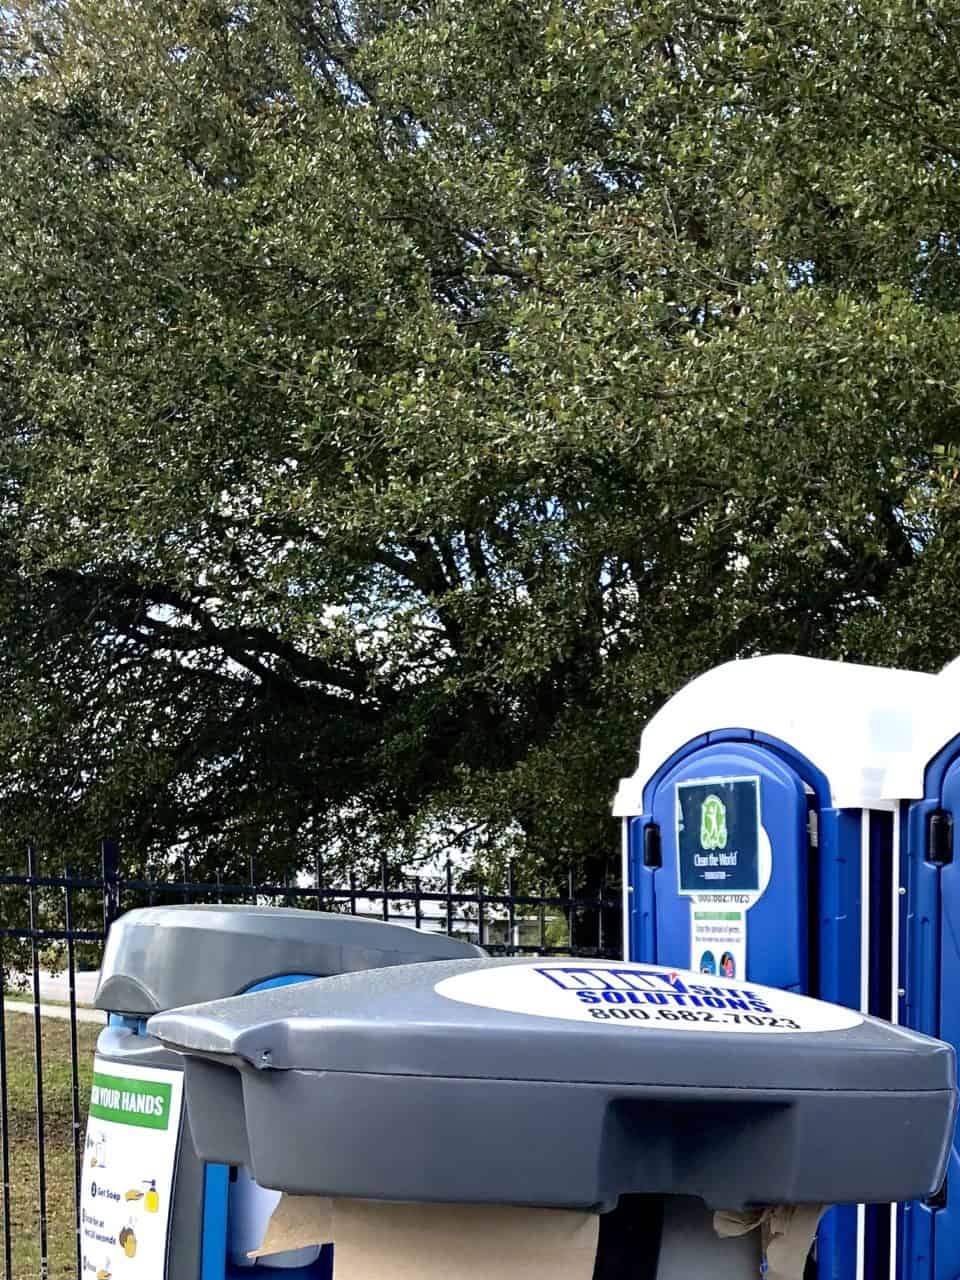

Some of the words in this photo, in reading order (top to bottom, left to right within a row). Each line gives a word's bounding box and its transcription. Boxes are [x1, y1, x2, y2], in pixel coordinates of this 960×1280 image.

[575, 990, 773, 1014] SOLUTIONS
[687, 984, 763, 1001] SITE
[588, 1007, 801, 1030] 800.682.7023
[122, 1091, 164, 1116] HANDS
